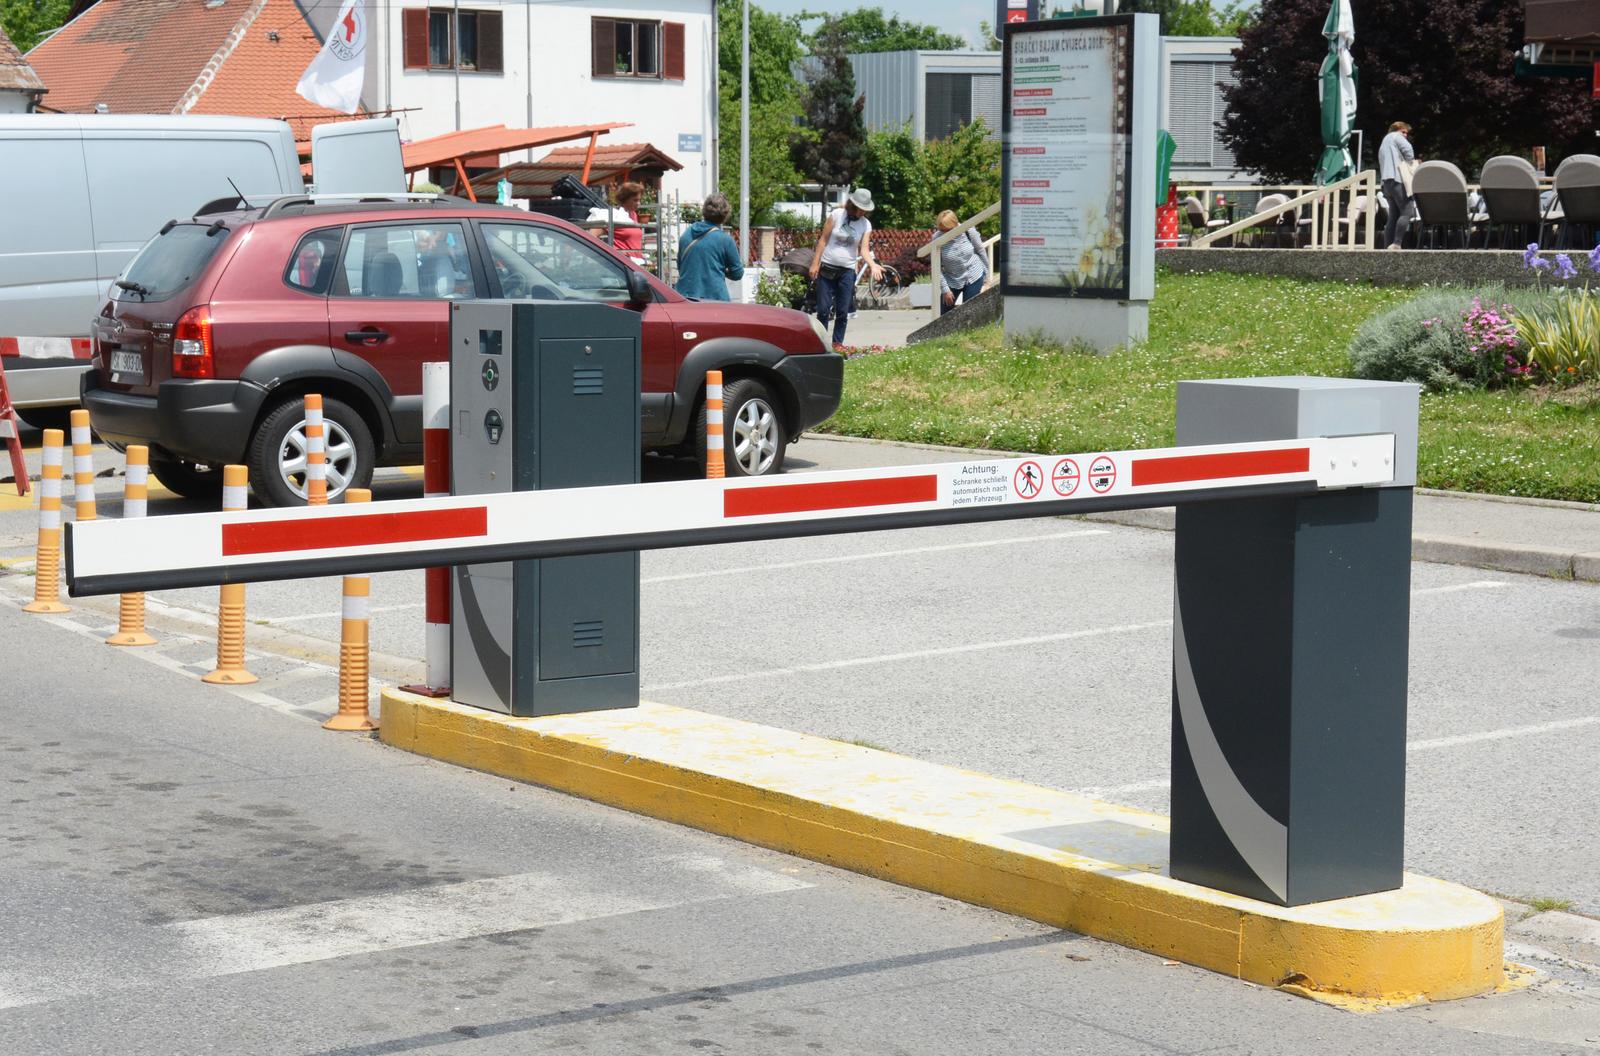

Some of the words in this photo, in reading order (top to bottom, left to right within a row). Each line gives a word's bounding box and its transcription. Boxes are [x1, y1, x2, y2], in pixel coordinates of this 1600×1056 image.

[962, 465, 999, 475] Achtung:
[952, 478, 982, 486] Schranke
[983, 476, 1008, 484] schließt
[952, 487, 991, 495] automatisch
[952, 496, 972, 506] jedem
[974, 494, 1003, 503] Fahrzeug
